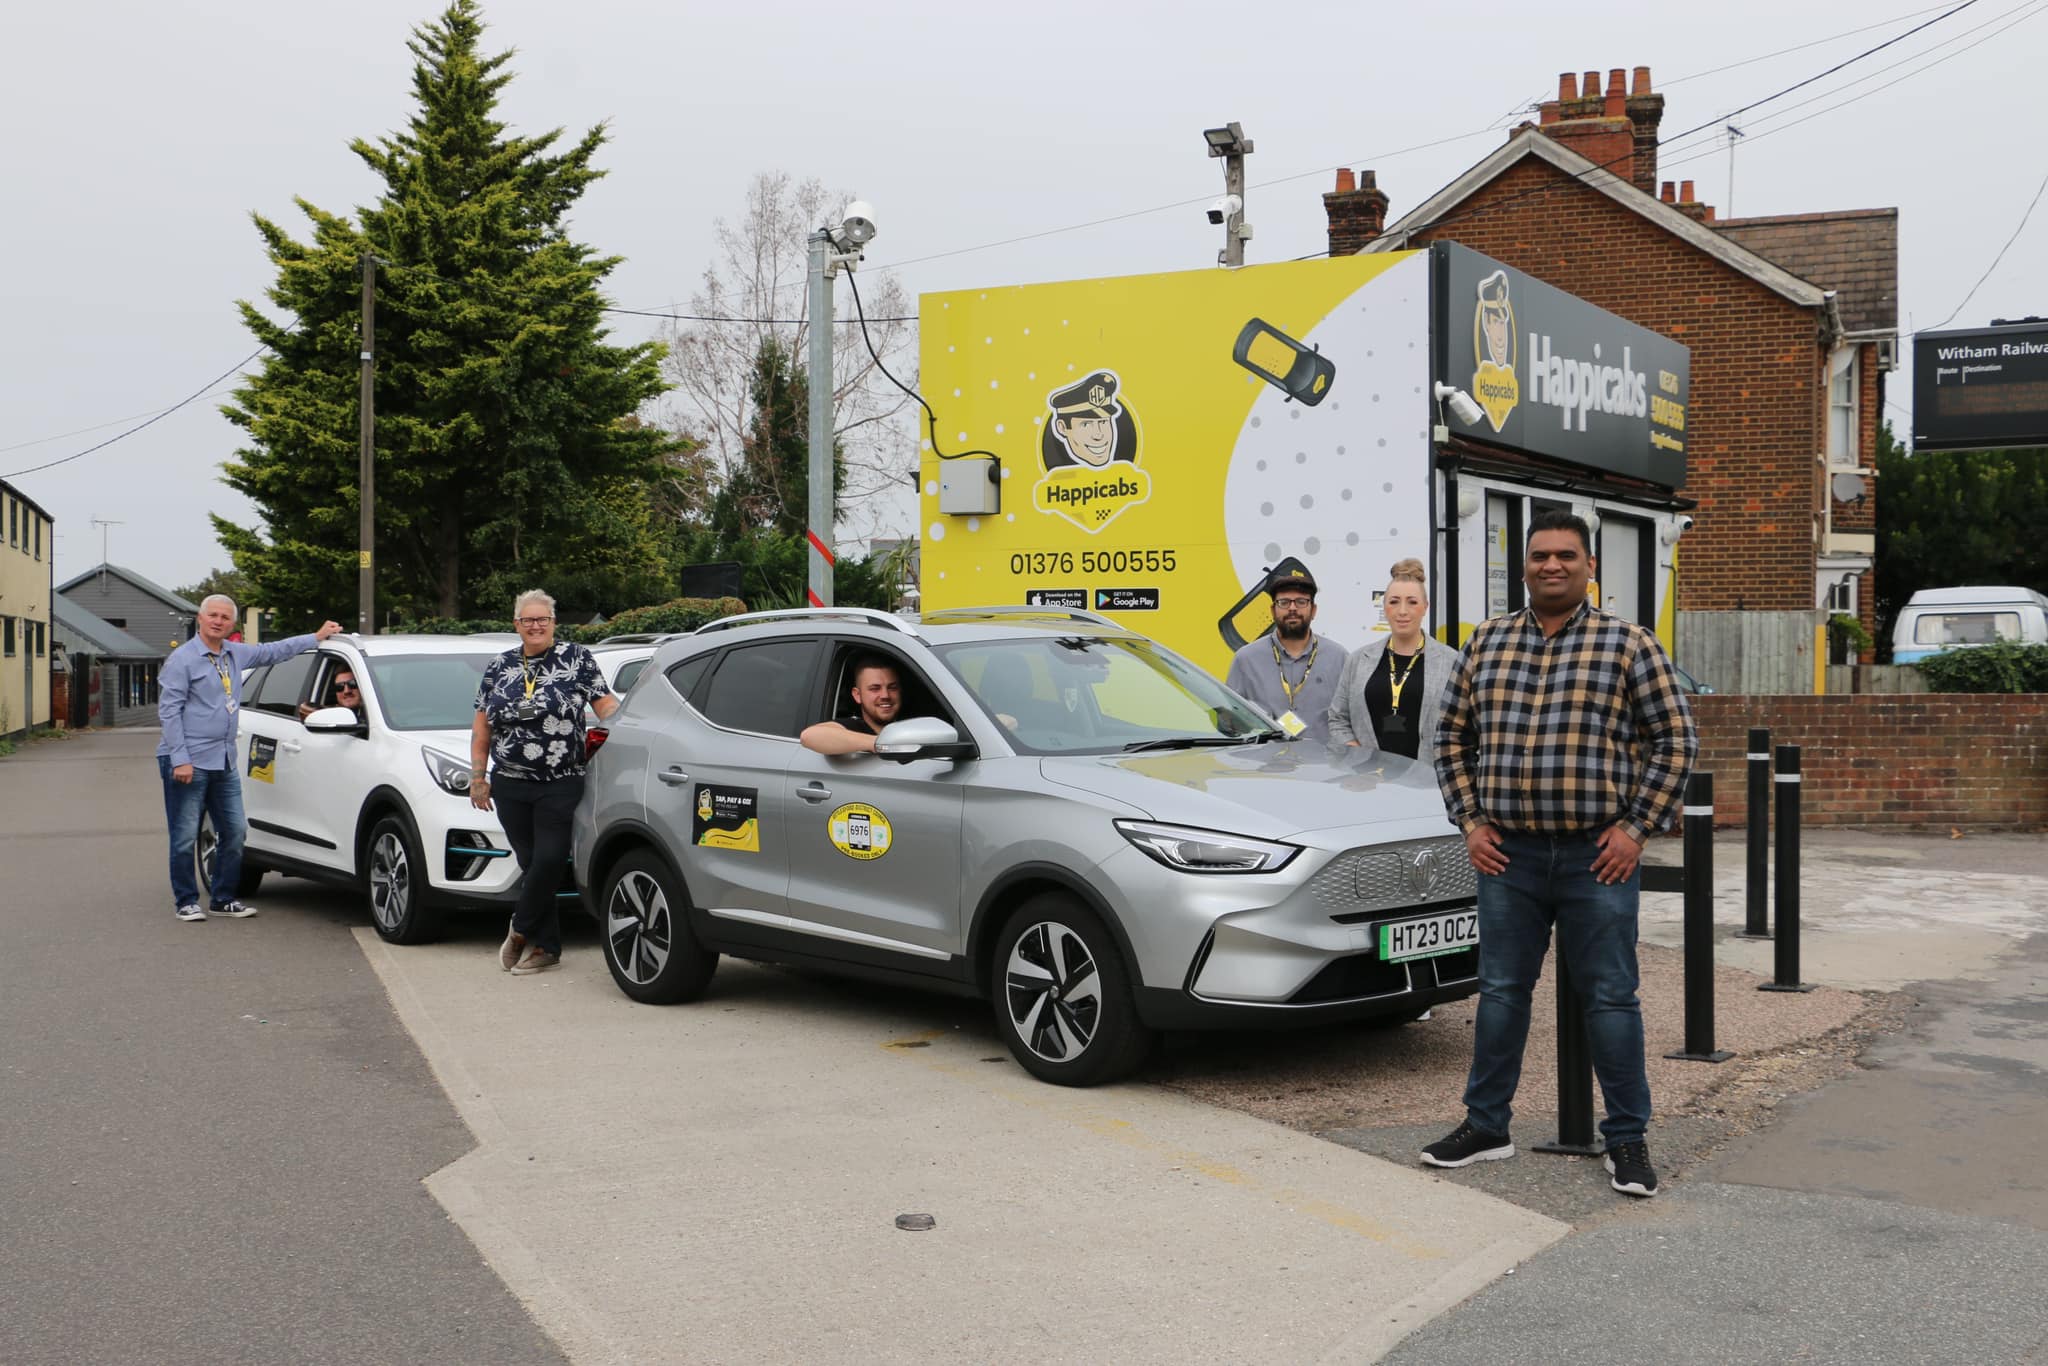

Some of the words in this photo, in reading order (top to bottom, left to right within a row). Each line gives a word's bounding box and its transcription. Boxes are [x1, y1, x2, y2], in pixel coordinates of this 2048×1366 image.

[1937, 346, 1997, 360] Witham
[1480, 378, 1515, 403] Happicabs
[1529, 332, 1646, 432] Happicabs
[1046, 477, 1138, 506] Happicabs
[1010, 551, 1074, 575] 01376
[1082, 550, 1176, 573] 500555
[1062, 598, 1082, 607] Store
[1113, 597, 1138, 608] Google
[1139, 597, 1156, 608] Play
[850, 825, 869, 836] 6976
[1393, 921, 1439, 953] HT23
